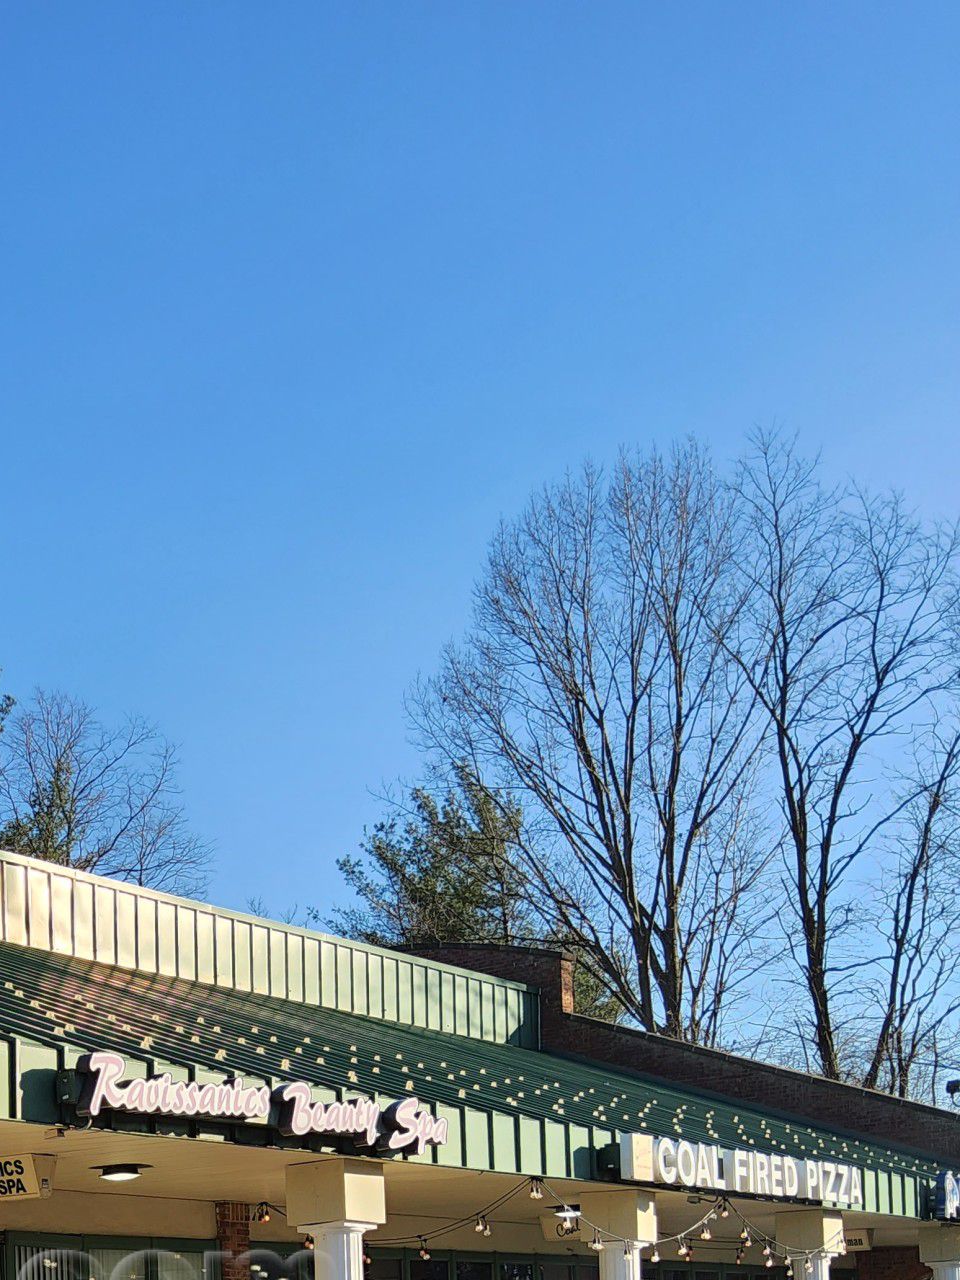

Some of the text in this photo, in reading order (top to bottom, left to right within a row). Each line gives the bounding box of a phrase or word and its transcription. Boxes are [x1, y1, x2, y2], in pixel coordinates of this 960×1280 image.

[90, 1052, 448, 1155] Ravissanics Beauty Spa
[658, 1137, 863, 1204] COAL FIRED PIZZA
